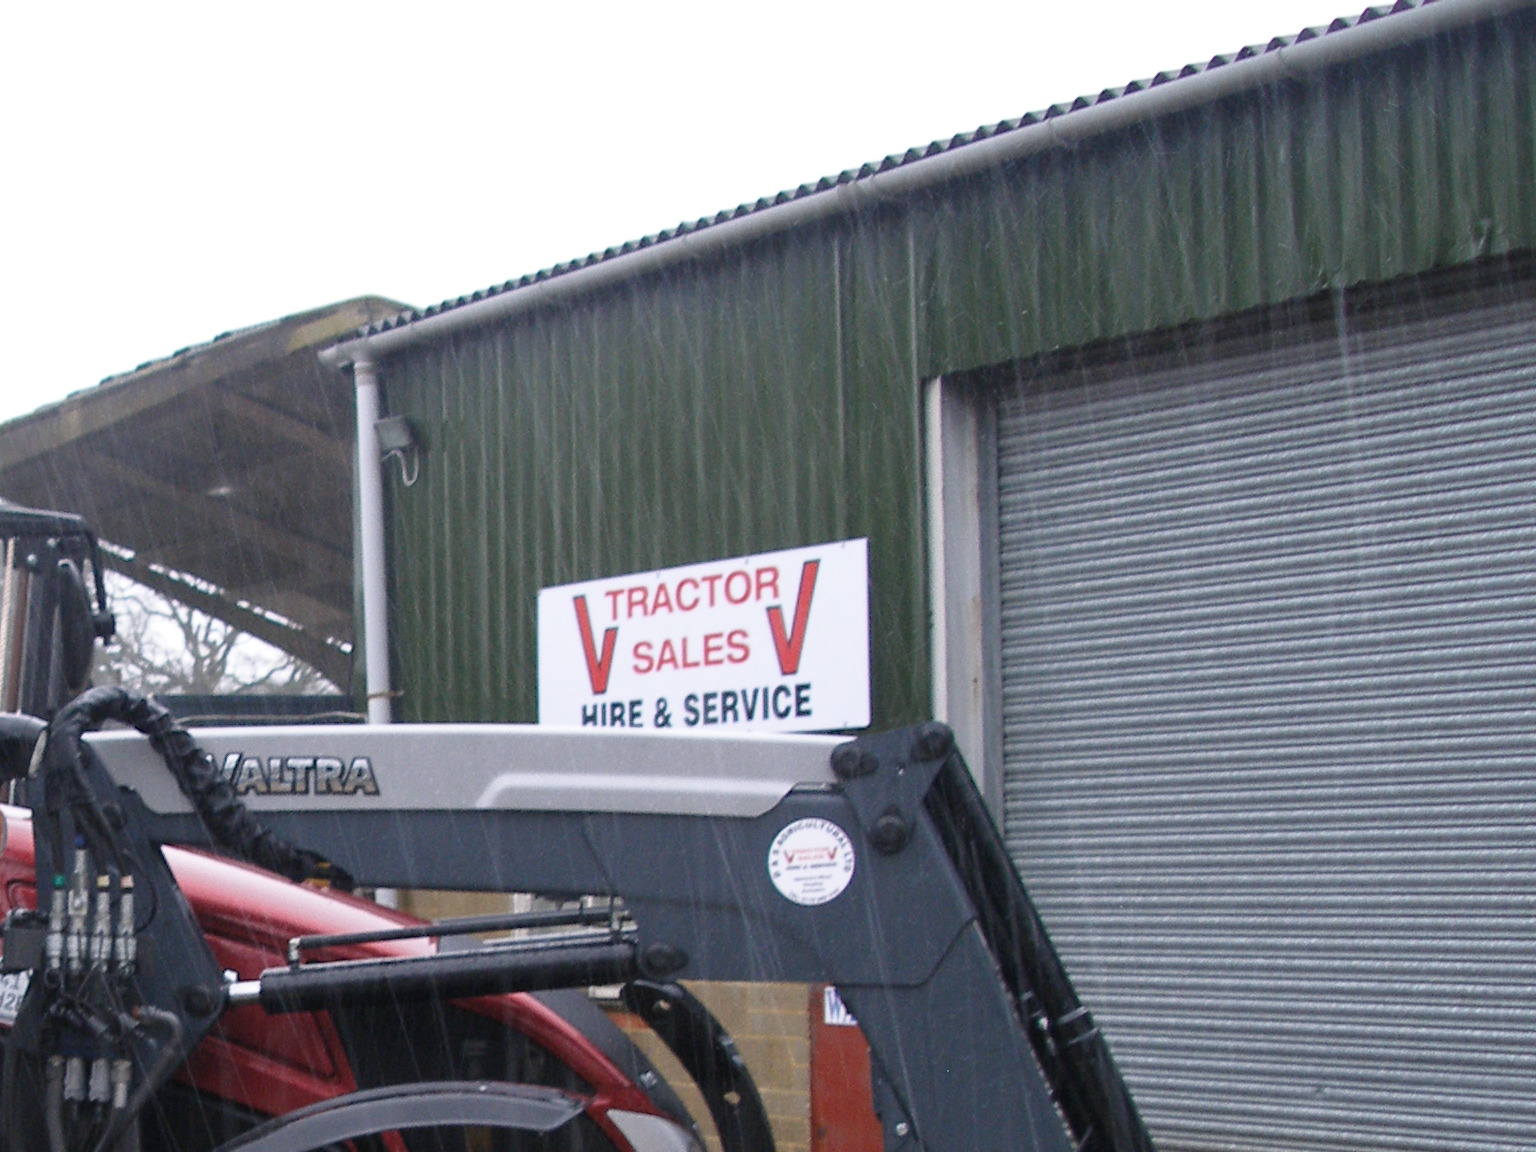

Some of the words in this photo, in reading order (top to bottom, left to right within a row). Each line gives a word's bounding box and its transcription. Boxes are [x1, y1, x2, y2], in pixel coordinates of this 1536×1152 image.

[605, 566, 780, 621] TRACTOR
[632, 629, 751, 675] SALES
[582, 700, 643, 728] HIRE
[654, 697, 672, 729] &
[684, 683, 812, 726] SERVICE
